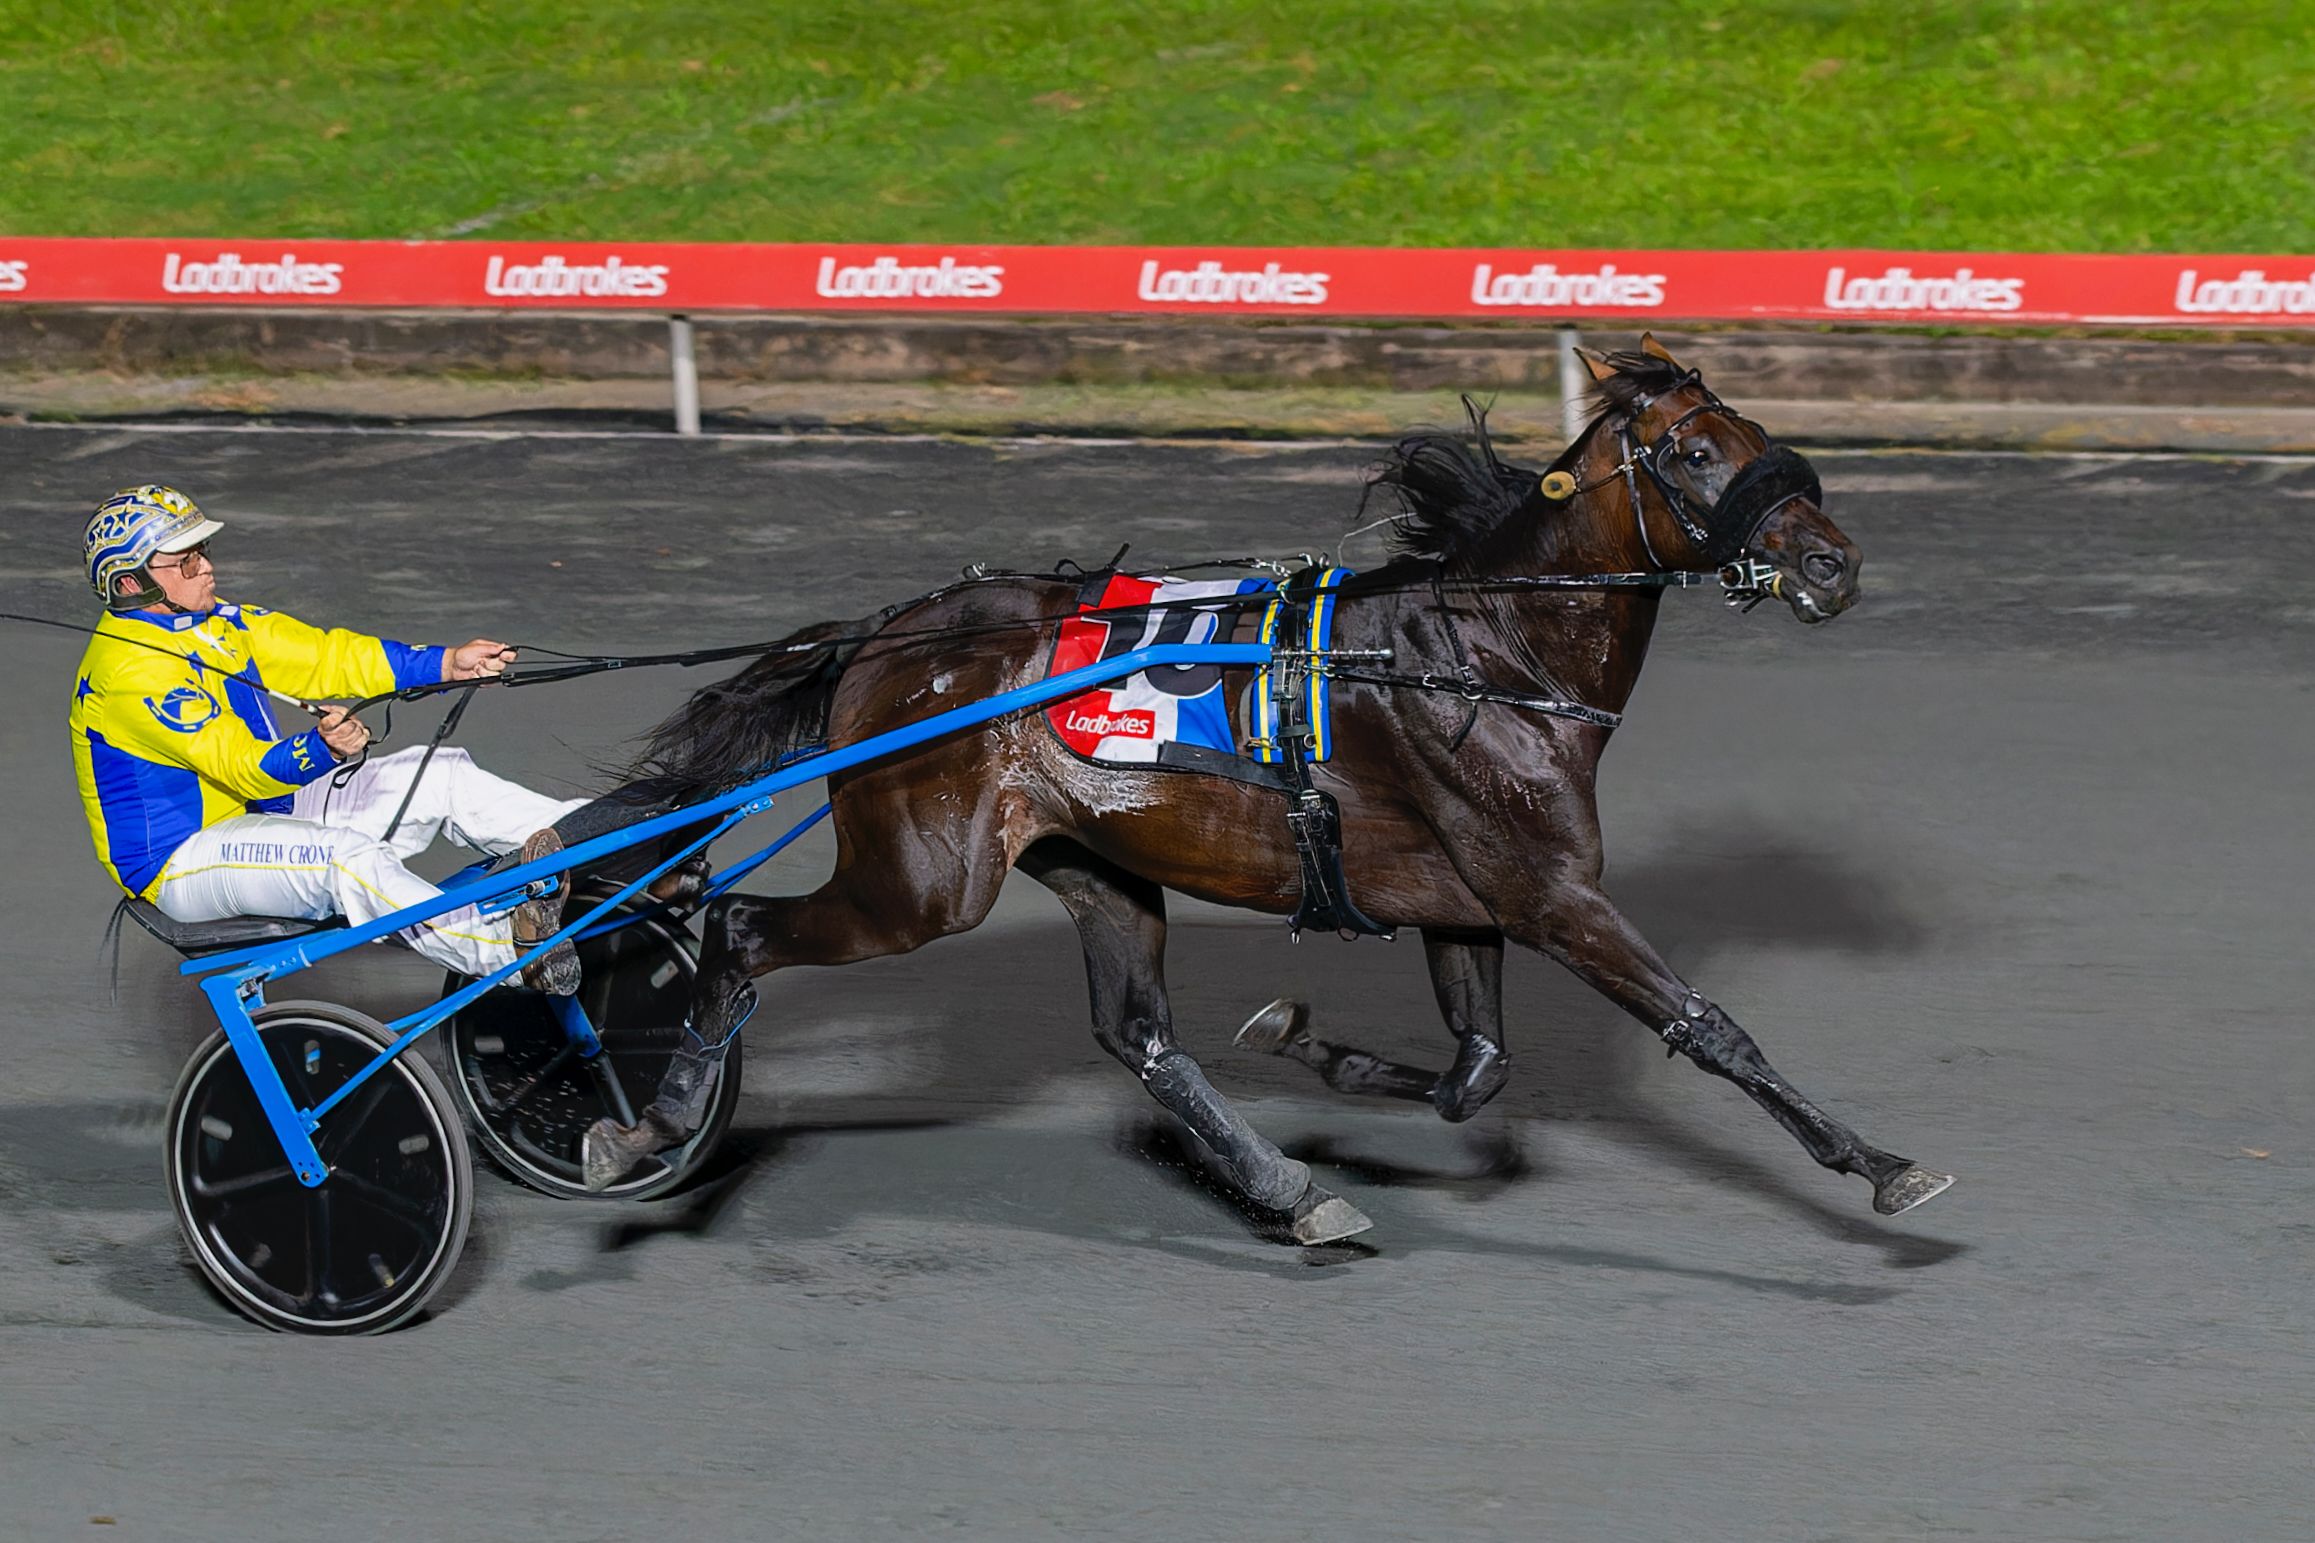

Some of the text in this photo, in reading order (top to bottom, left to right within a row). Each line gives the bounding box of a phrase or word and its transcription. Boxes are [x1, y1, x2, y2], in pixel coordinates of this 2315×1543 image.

[162, 253, 344, 294] Ladbrokes
[485, 256, 669, 297] Ladbrokes
[816, 256, 1004, 298] Ladbrokes
[1138, 260, 1330, 304] Ladbrokes
[1471, 264, 1667, 307] Ladbrokes
[1824, 267, 2024, 311] Ladbrokes
[2174, 269, 2315, 313] Ladbro
[1065, 710, 1150, 735] Ladbkes
[221, 842, 285, 863] MATTHEW
